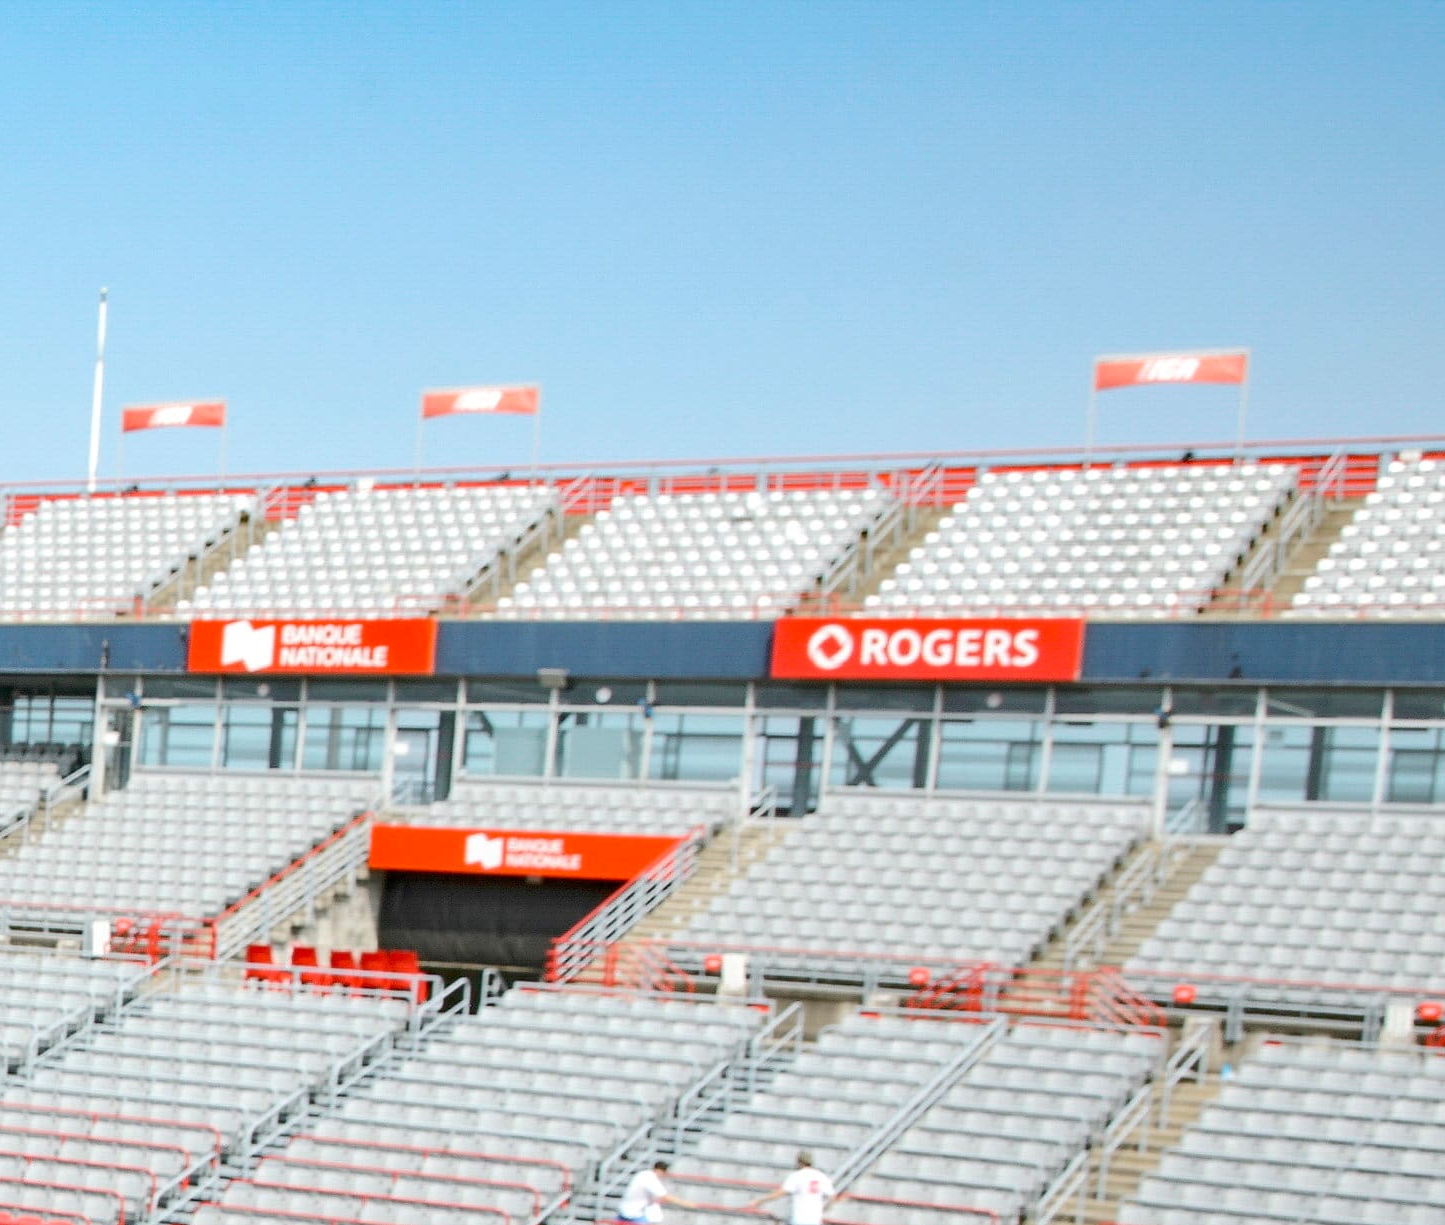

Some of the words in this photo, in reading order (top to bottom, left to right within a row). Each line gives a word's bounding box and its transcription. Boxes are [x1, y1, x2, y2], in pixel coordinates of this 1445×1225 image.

[280, 623, 364, 646] BANQUE
[279, 645, 390, 668] NATIONALE
[860, 628, 1041, 668] ROGERS
